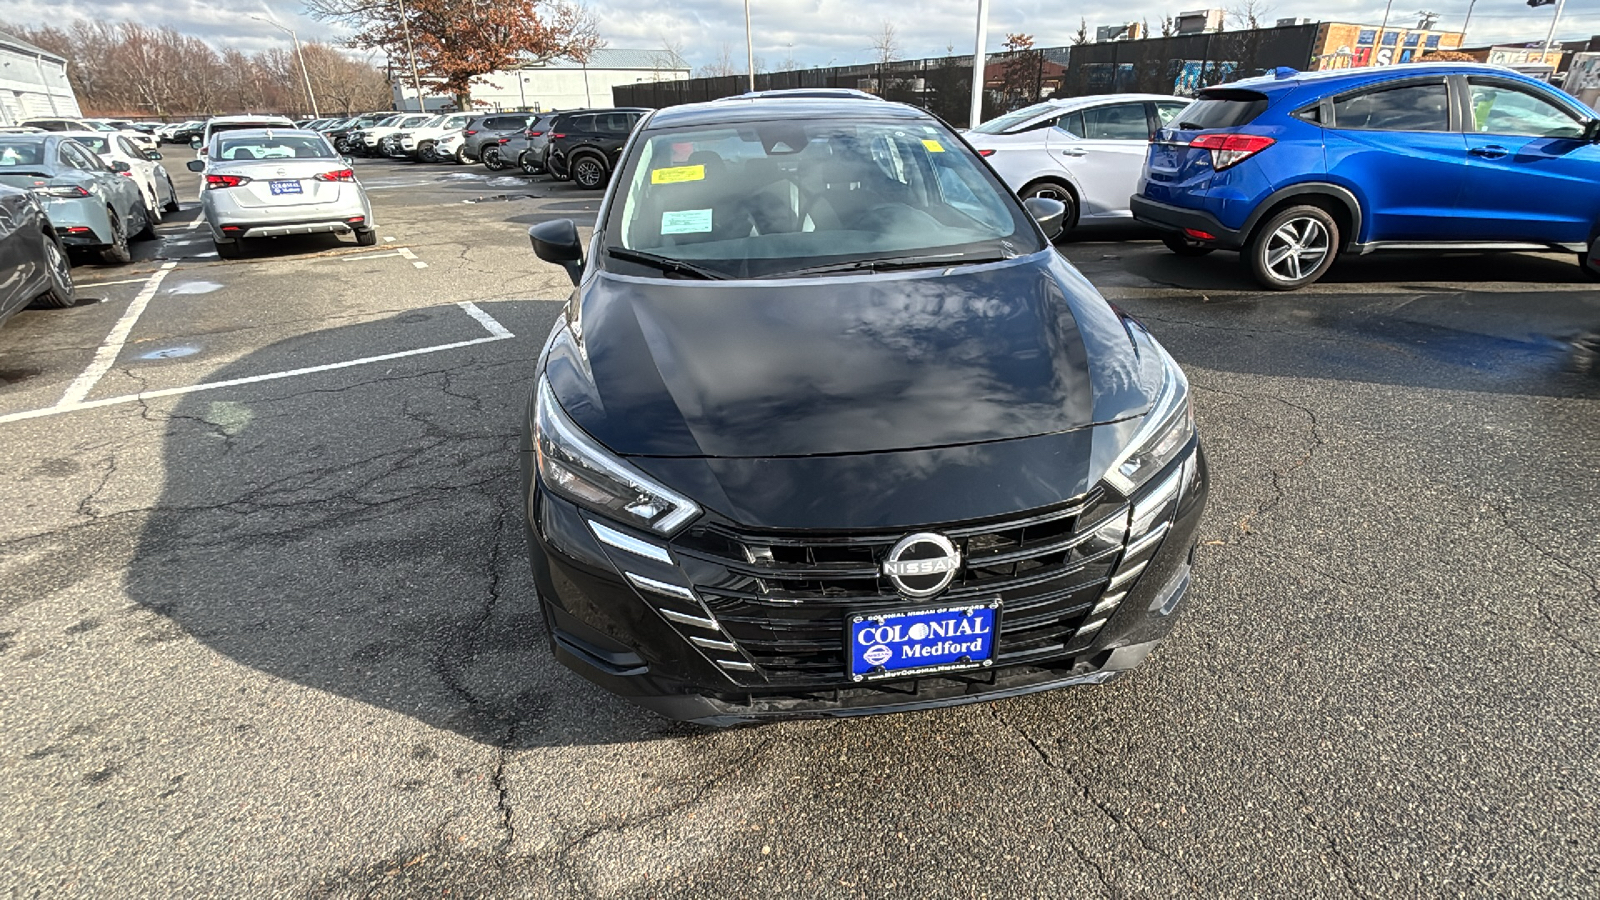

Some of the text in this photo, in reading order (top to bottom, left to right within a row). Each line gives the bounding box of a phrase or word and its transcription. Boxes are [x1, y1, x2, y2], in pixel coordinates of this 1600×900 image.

[884, 554, 961, 573] NISSAN
[907, 609, 936, 617] NISSAN
[858, 617, 990, 645] COLONIAL
[902, 638, 982, 659] Medford
